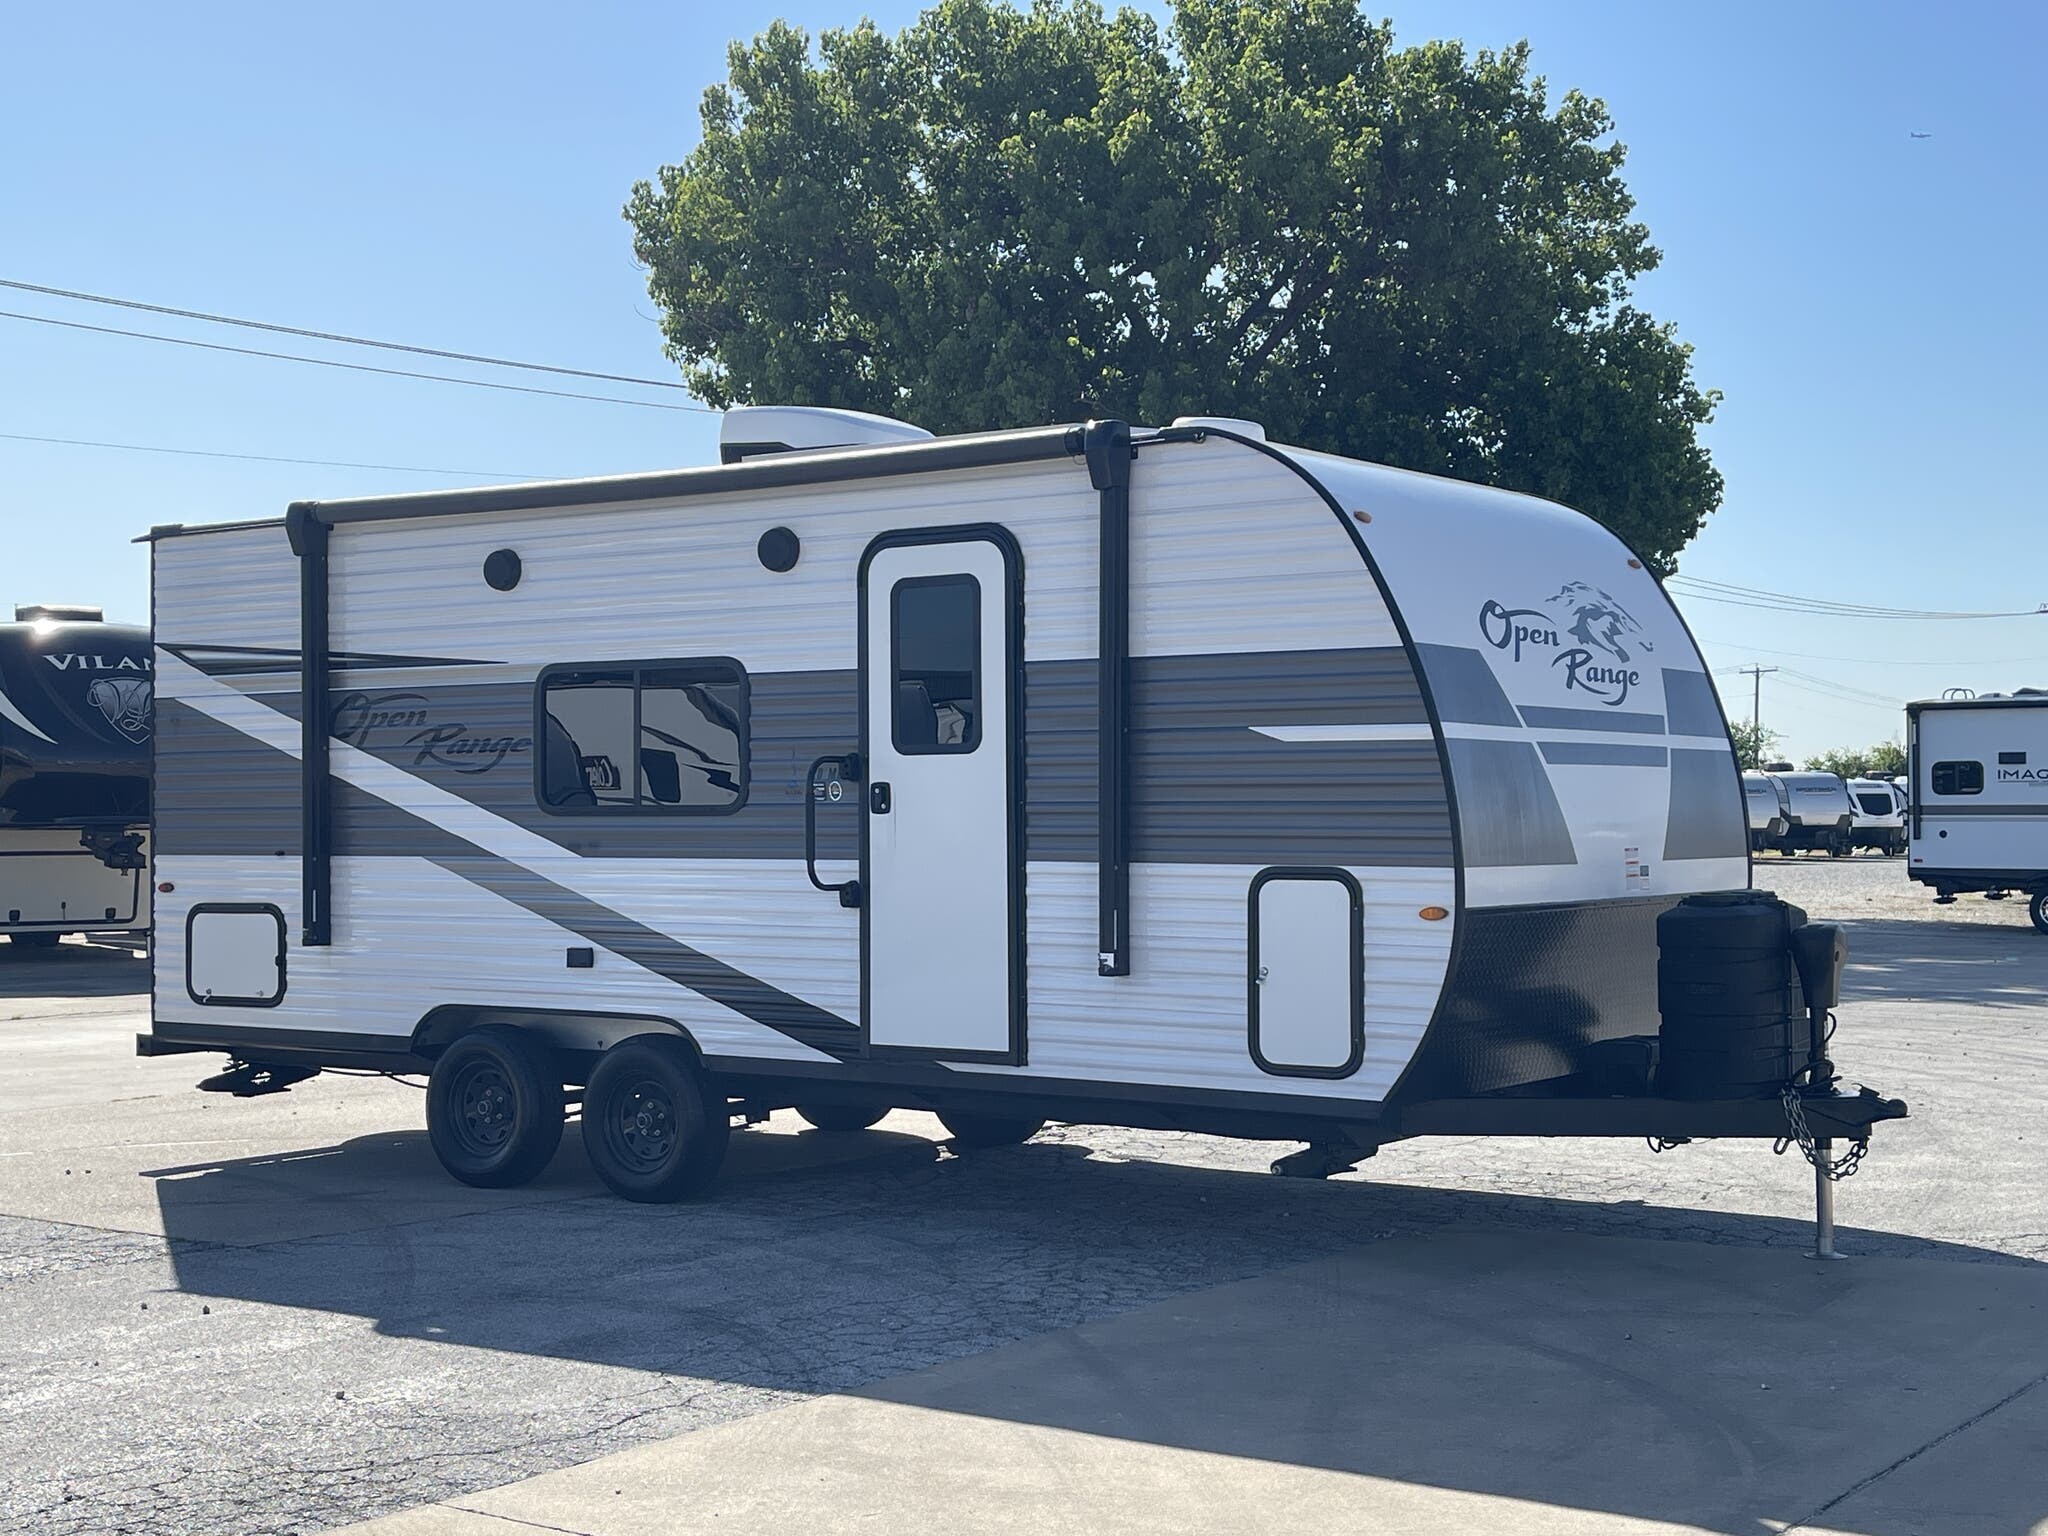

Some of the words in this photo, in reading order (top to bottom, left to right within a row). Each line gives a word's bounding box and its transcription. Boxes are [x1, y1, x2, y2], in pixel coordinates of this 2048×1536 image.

[1479, 599, 1560, 663] Open
[1551, 648, 1640, 706] Range
[329, 692, 430, 749] Open
[404, 723, 533, 775] Range
